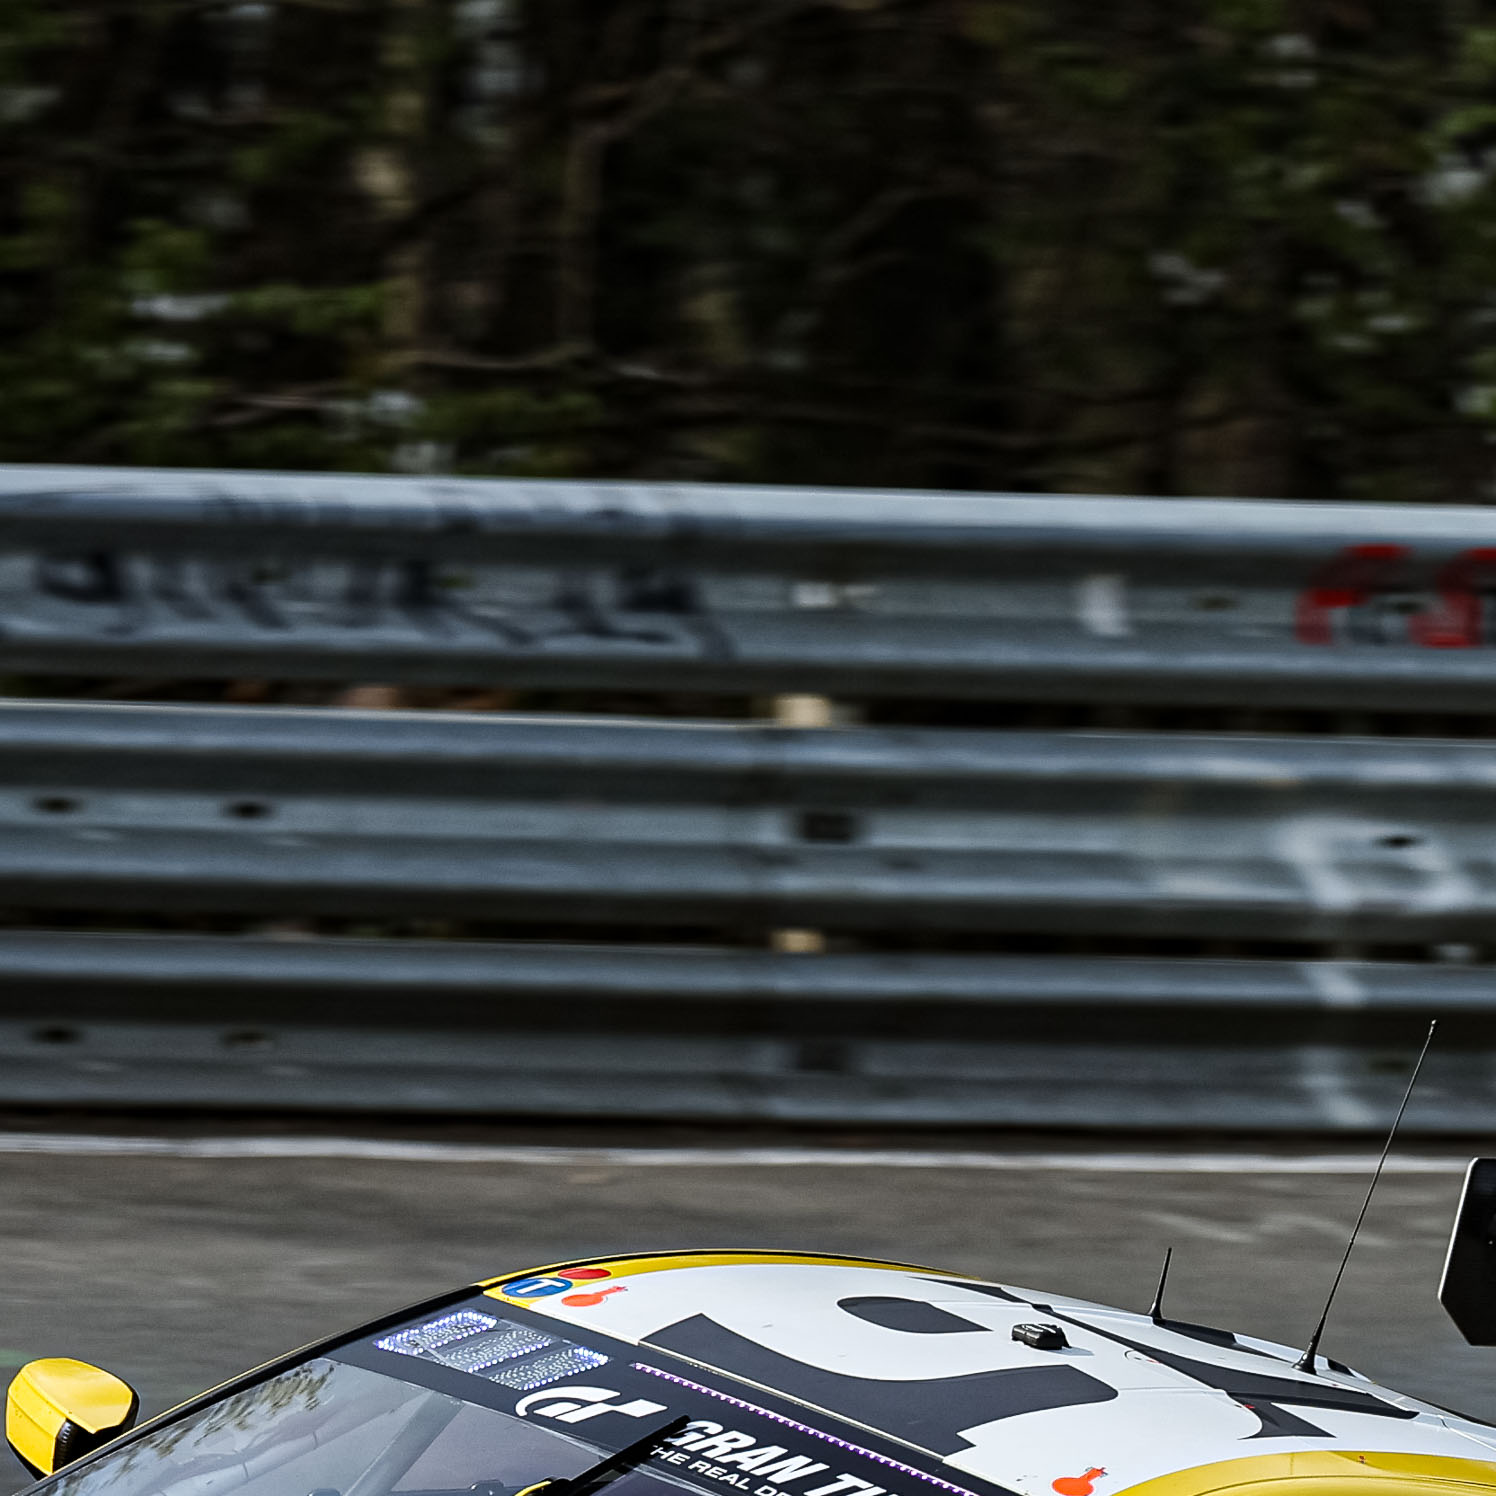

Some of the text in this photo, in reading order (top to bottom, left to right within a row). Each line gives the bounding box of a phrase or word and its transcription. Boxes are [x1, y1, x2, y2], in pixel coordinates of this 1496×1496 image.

[650, 1444, 691, 1466] HE
[688, 1459, 751, 1491] REAL
[663, 1419, 831, 1485] GRAN
